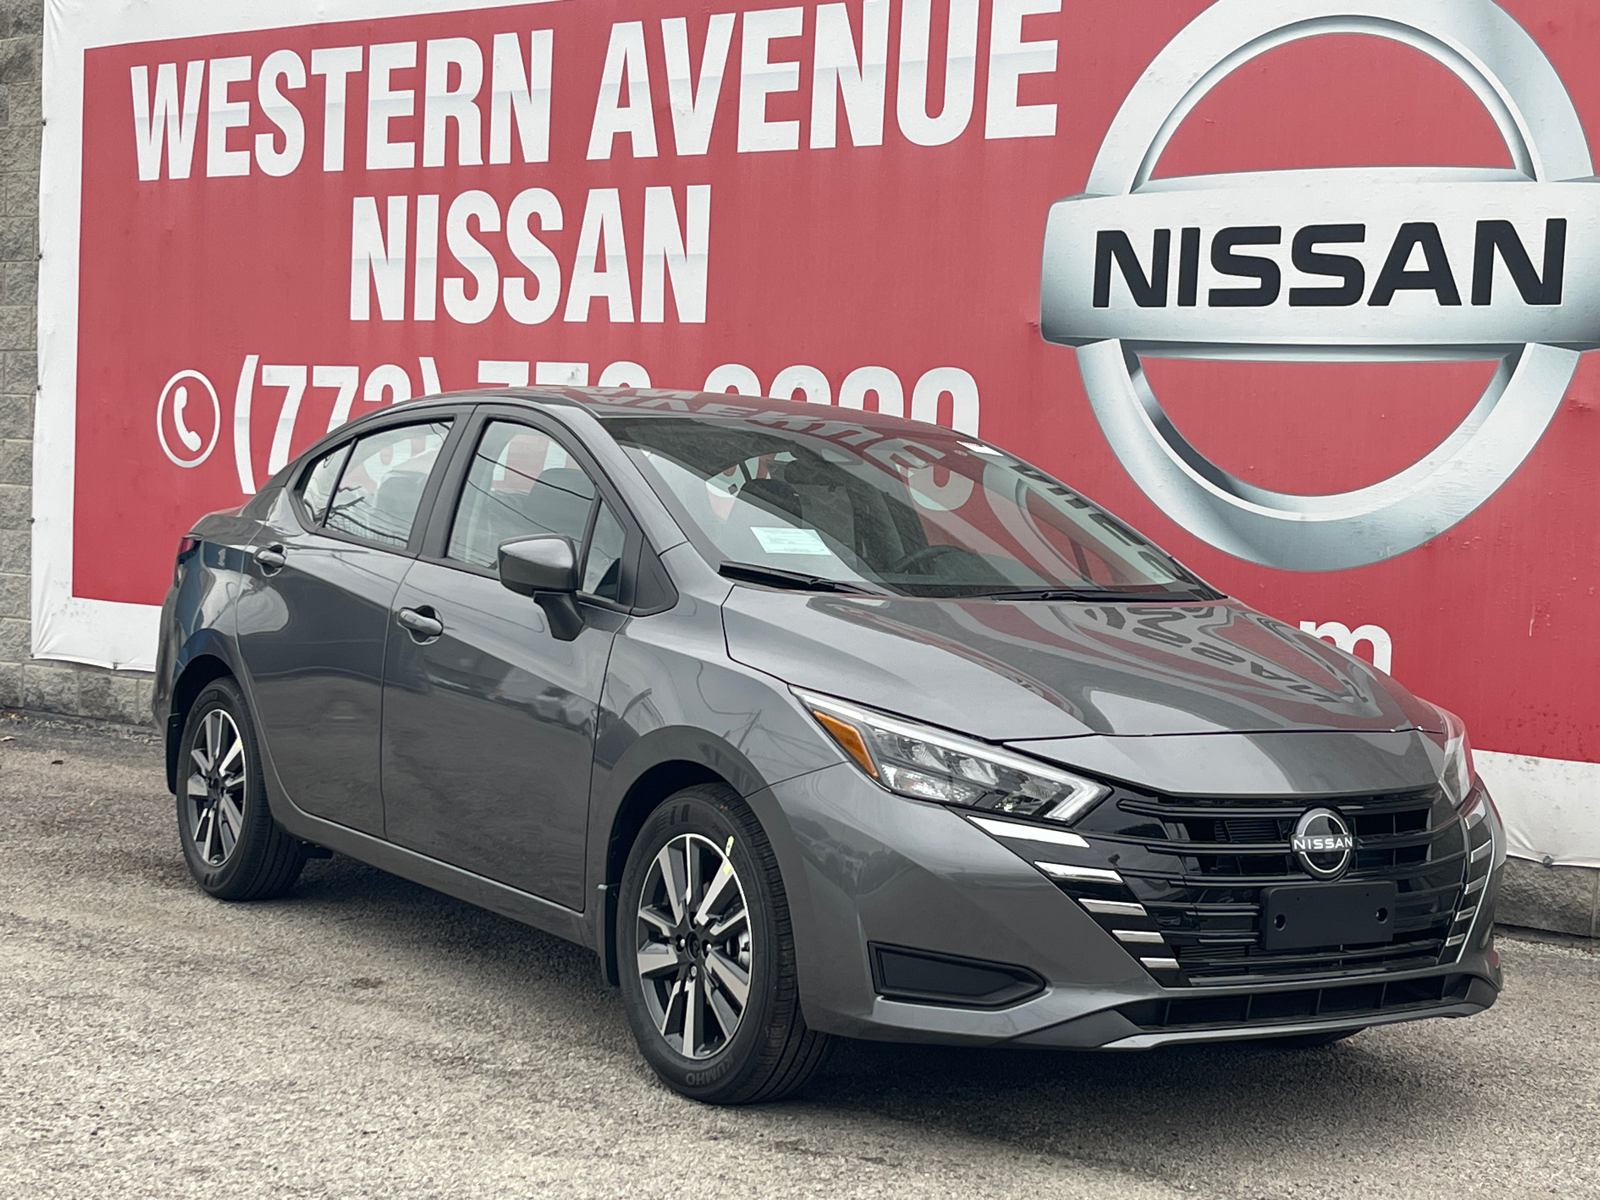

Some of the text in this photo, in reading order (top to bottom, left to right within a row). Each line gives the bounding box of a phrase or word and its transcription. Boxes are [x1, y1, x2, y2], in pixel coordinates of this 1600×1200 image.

[130, 0, 1063, 182] WESTERN AVENUE
[350, 184, 711, 325] NISSAN
[1092, 217, 1568, 308] NISSAN
[1293, 836, 1353, 850] NISSAN
[685, 1054, 734, 1086] KUMHO
